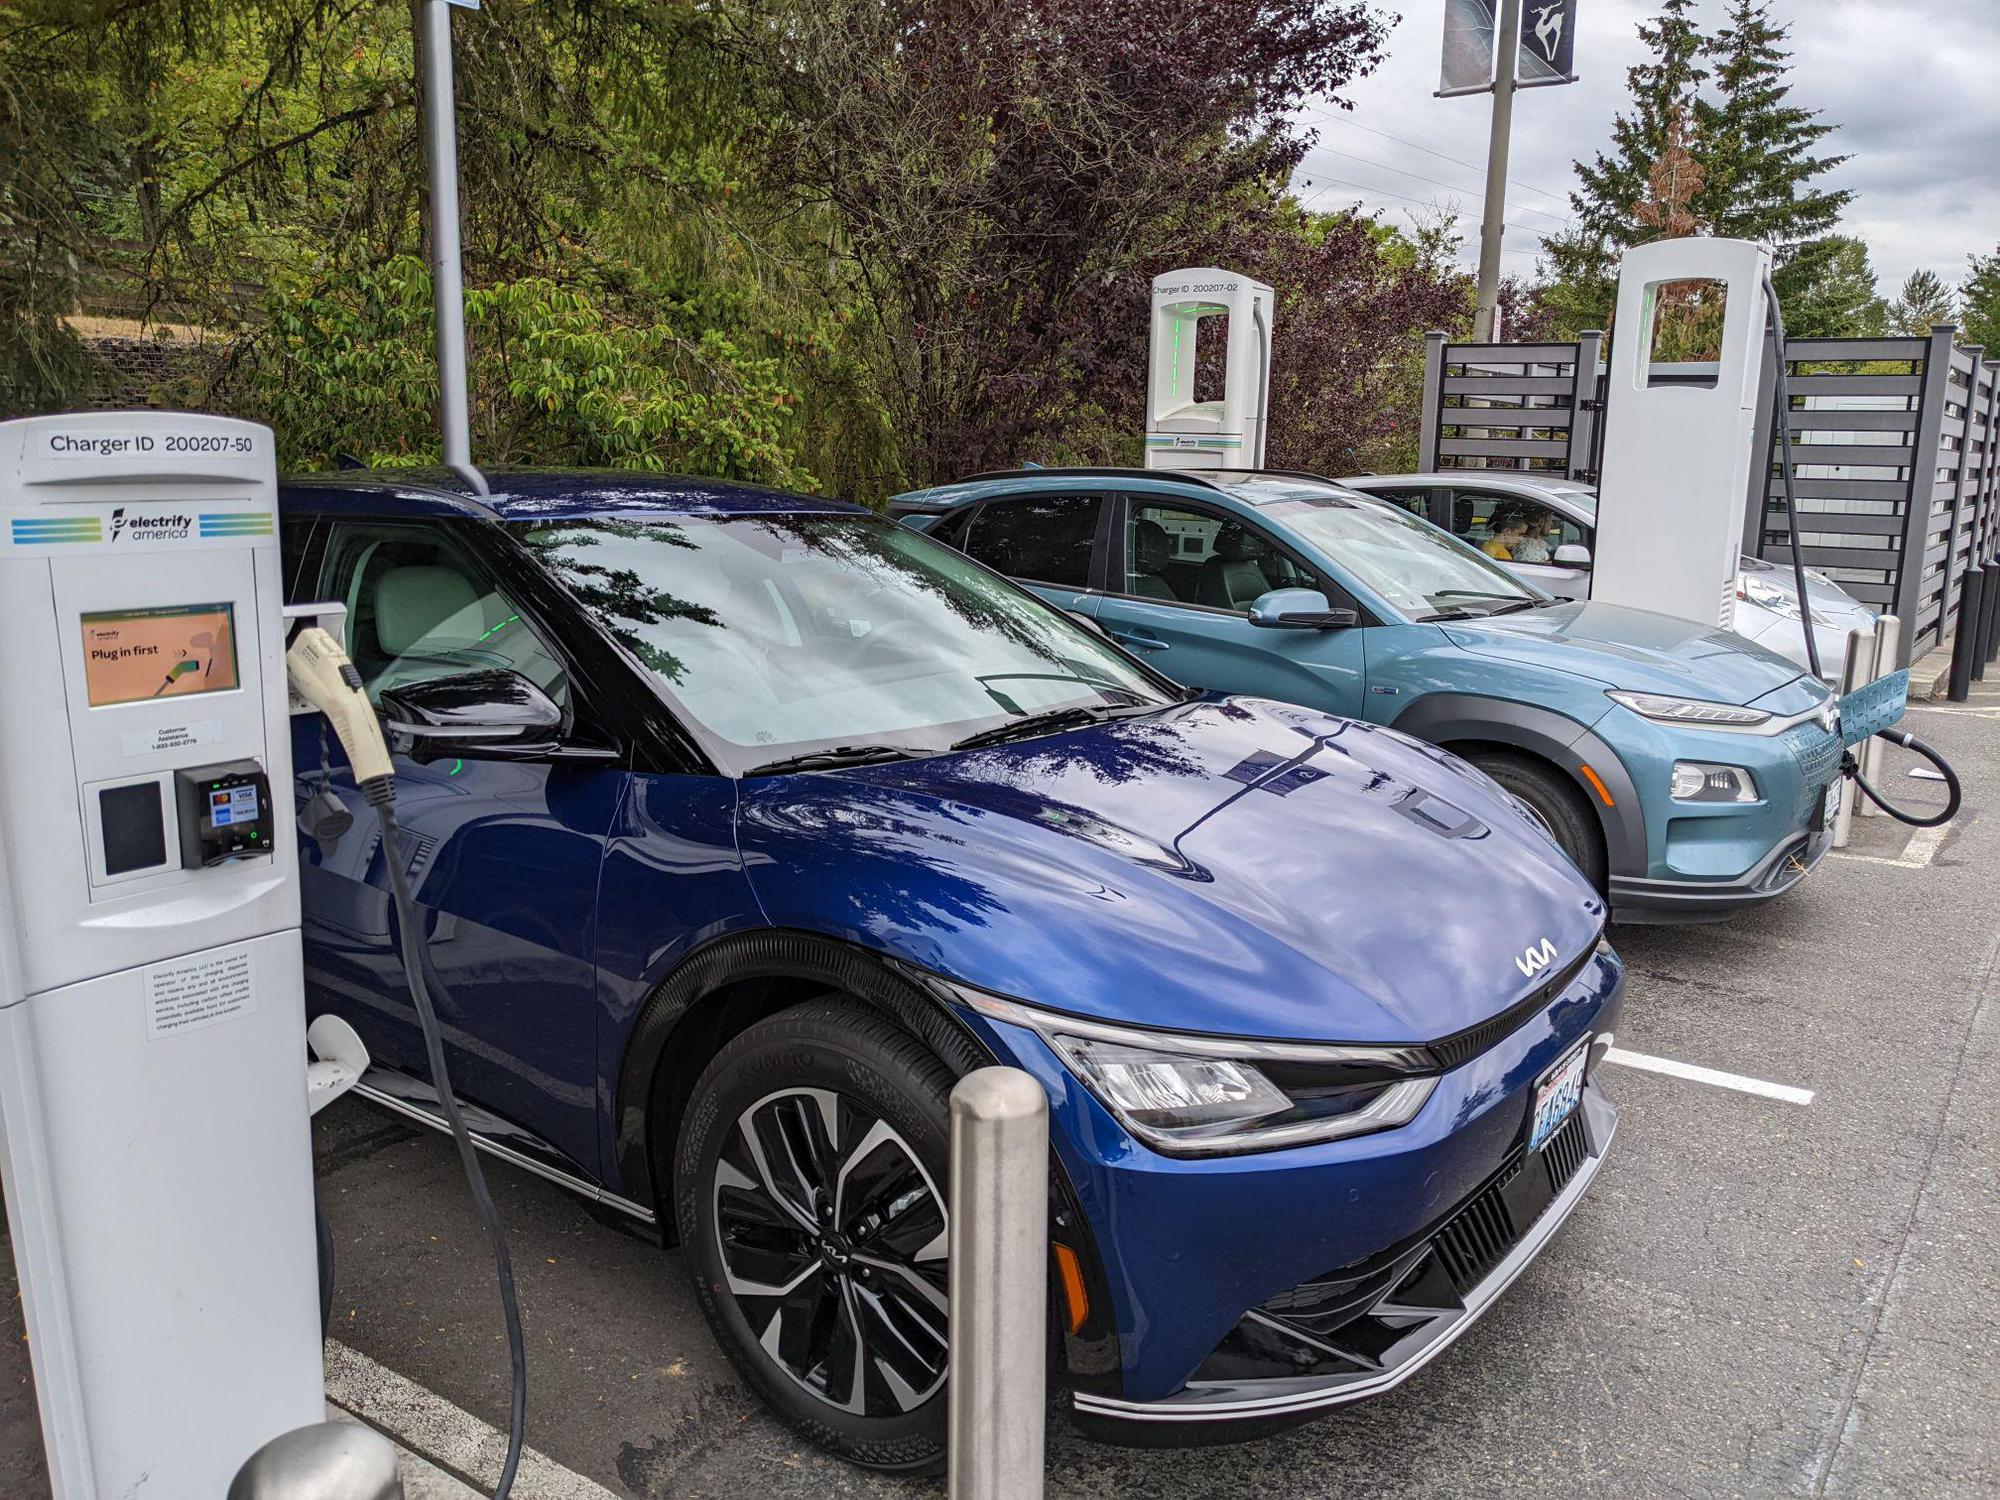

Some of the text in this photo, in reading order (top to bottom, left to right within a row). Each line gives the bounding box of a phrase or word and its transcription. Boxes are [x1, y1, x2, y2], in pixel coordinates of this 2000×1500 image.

[1153, 284, 1238, 295] Charger ID 200207-02
[50, 435, 252, 456] Charger ID 200207-50
[130, 514, 192, 528] electrify
[132, 528, 189, 541] america
[91, 644, 159, 661] Plug in first
[158, 726, 187, 735] Customer
[158, 733, 189, 742] Assistance
